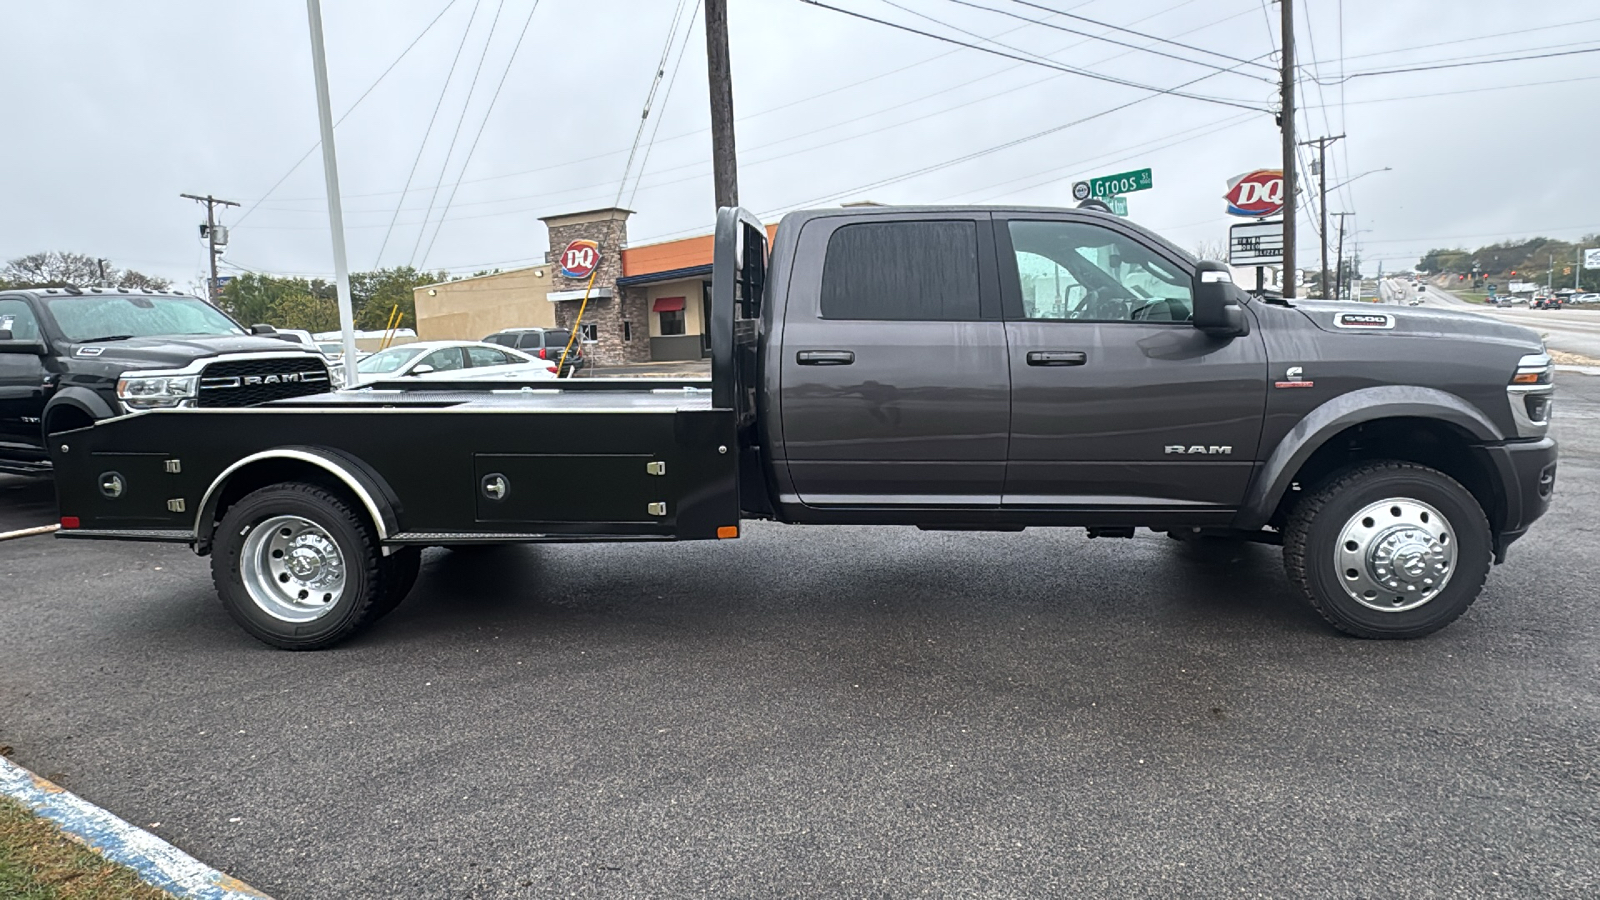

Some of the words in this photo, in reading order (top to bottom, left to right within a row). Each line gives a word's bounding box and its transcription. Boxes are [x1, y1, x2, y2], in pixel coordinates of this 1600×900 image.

[1095, 176, 1137, 196] Groos
[1141, 172, 1149, 180] St
[1236, 179, 1283, 205] DQ
[566, 247, 594, 269] DQ
[244, 373, 299, 386] RAM
[1164, 444, 1233, 454] RAM
